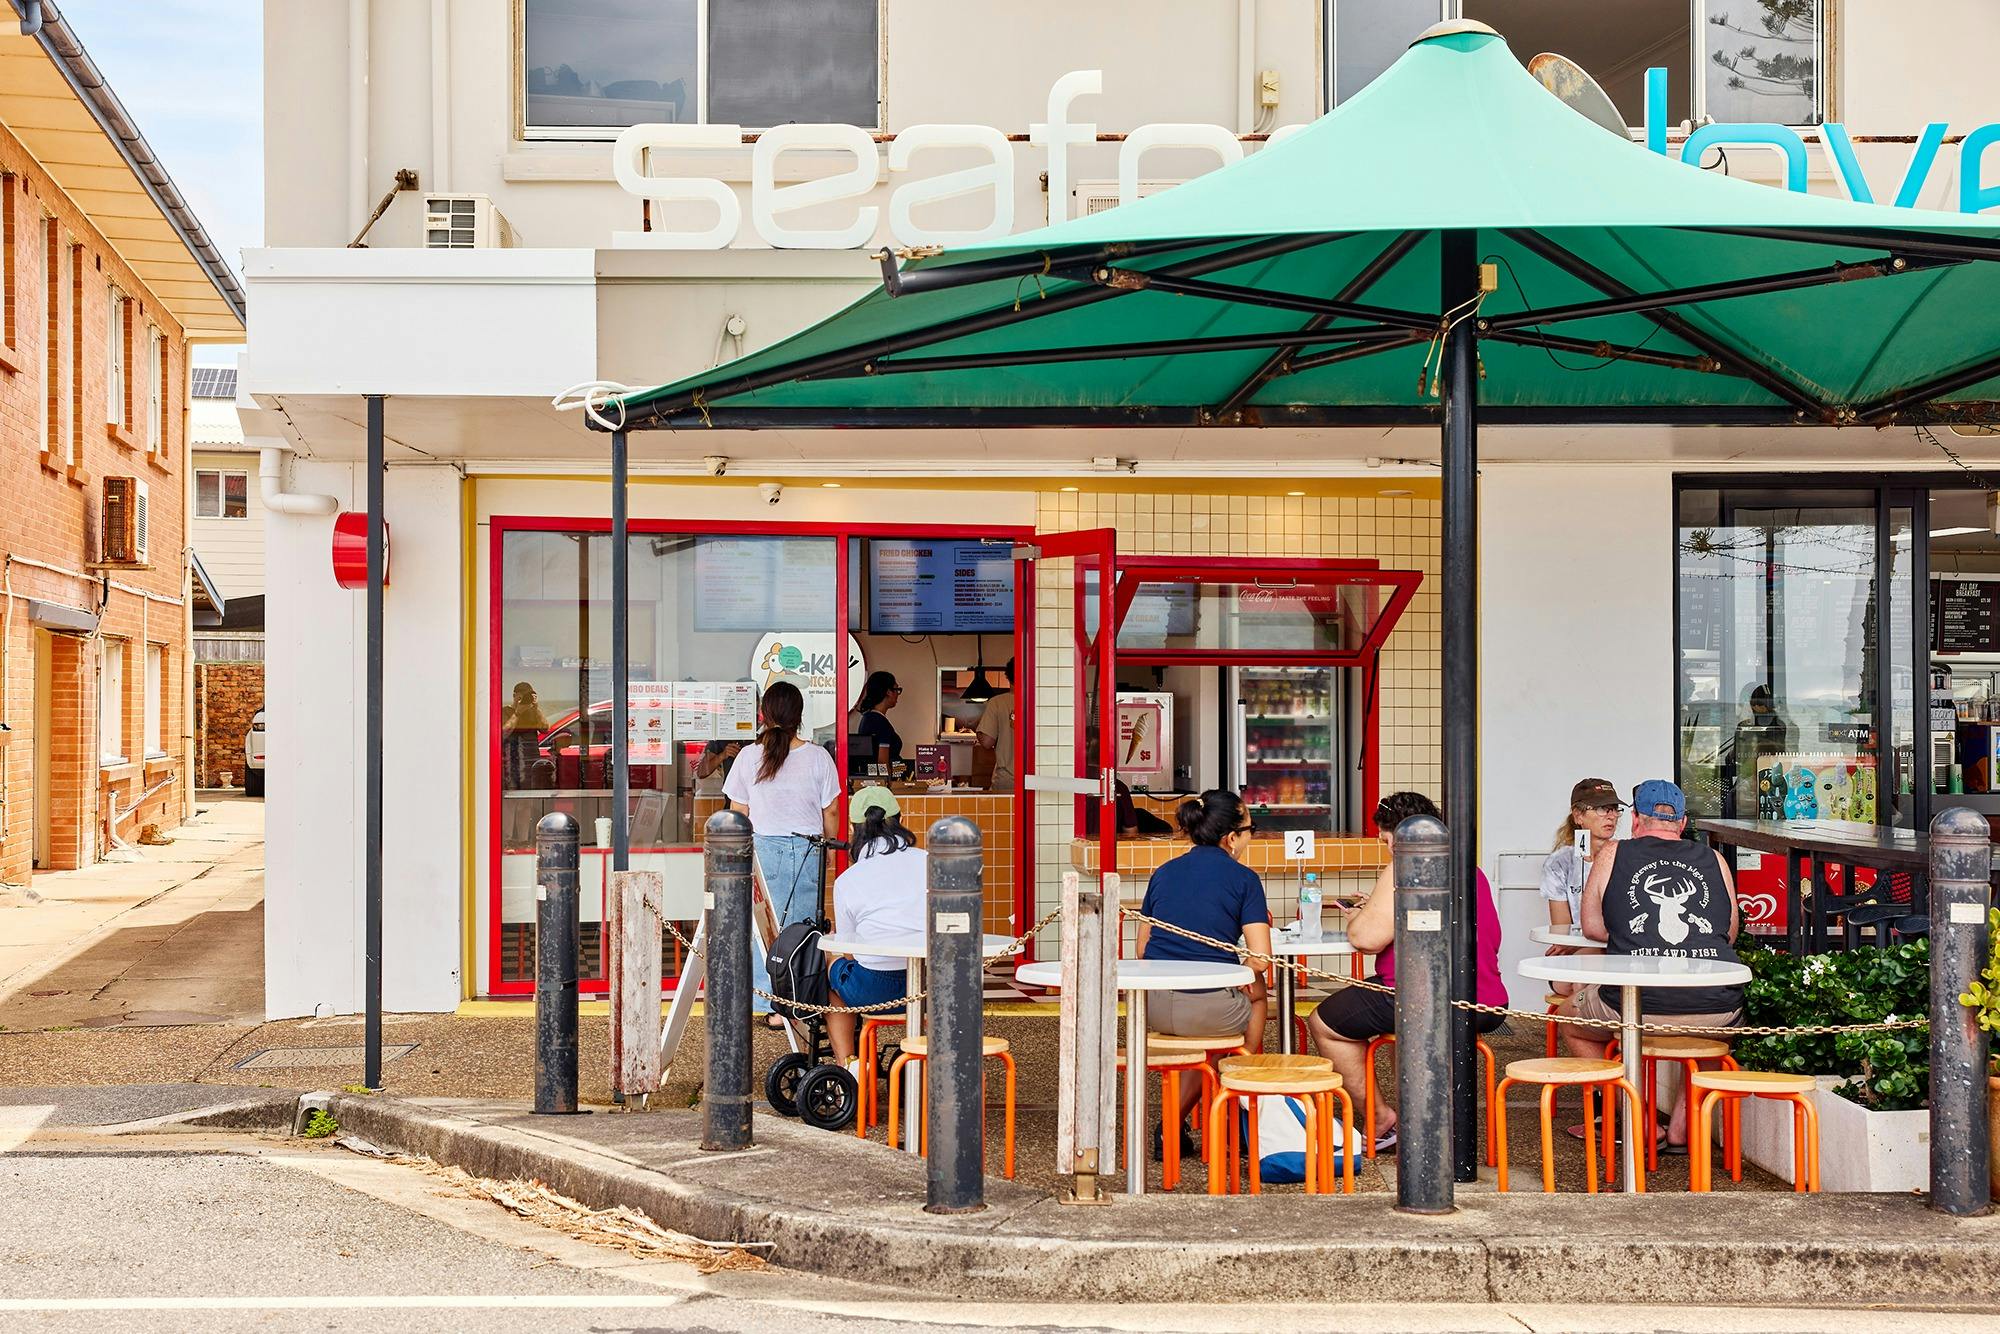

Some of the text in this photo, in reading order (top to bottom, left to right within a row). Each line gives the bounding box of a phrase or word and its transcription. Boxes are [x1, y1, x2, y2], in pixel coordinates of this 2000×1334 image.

[879, 549, 933, 557] FRIED CHICKEN
[954, 569, 976, 577] SIDES
[1955, 589, 1981, 597] BREAKFAST
[645, 685, 669, 693] DEALS
[1847, 729, 1869, 738] ATM
[1140, 750, 1151, 761] $5
[1295, 836, 1305, 854] 2
[1579, 834, 1586, 852] 4
[1631, 861, 1658, 885] gateway
[1672, 860, 1687, 870] the
[1687, 865, 1704, 881] high
[1699, 881, 1710, 909] country
[1630, 947, 1719, 958] HUNT 4WD FISH
